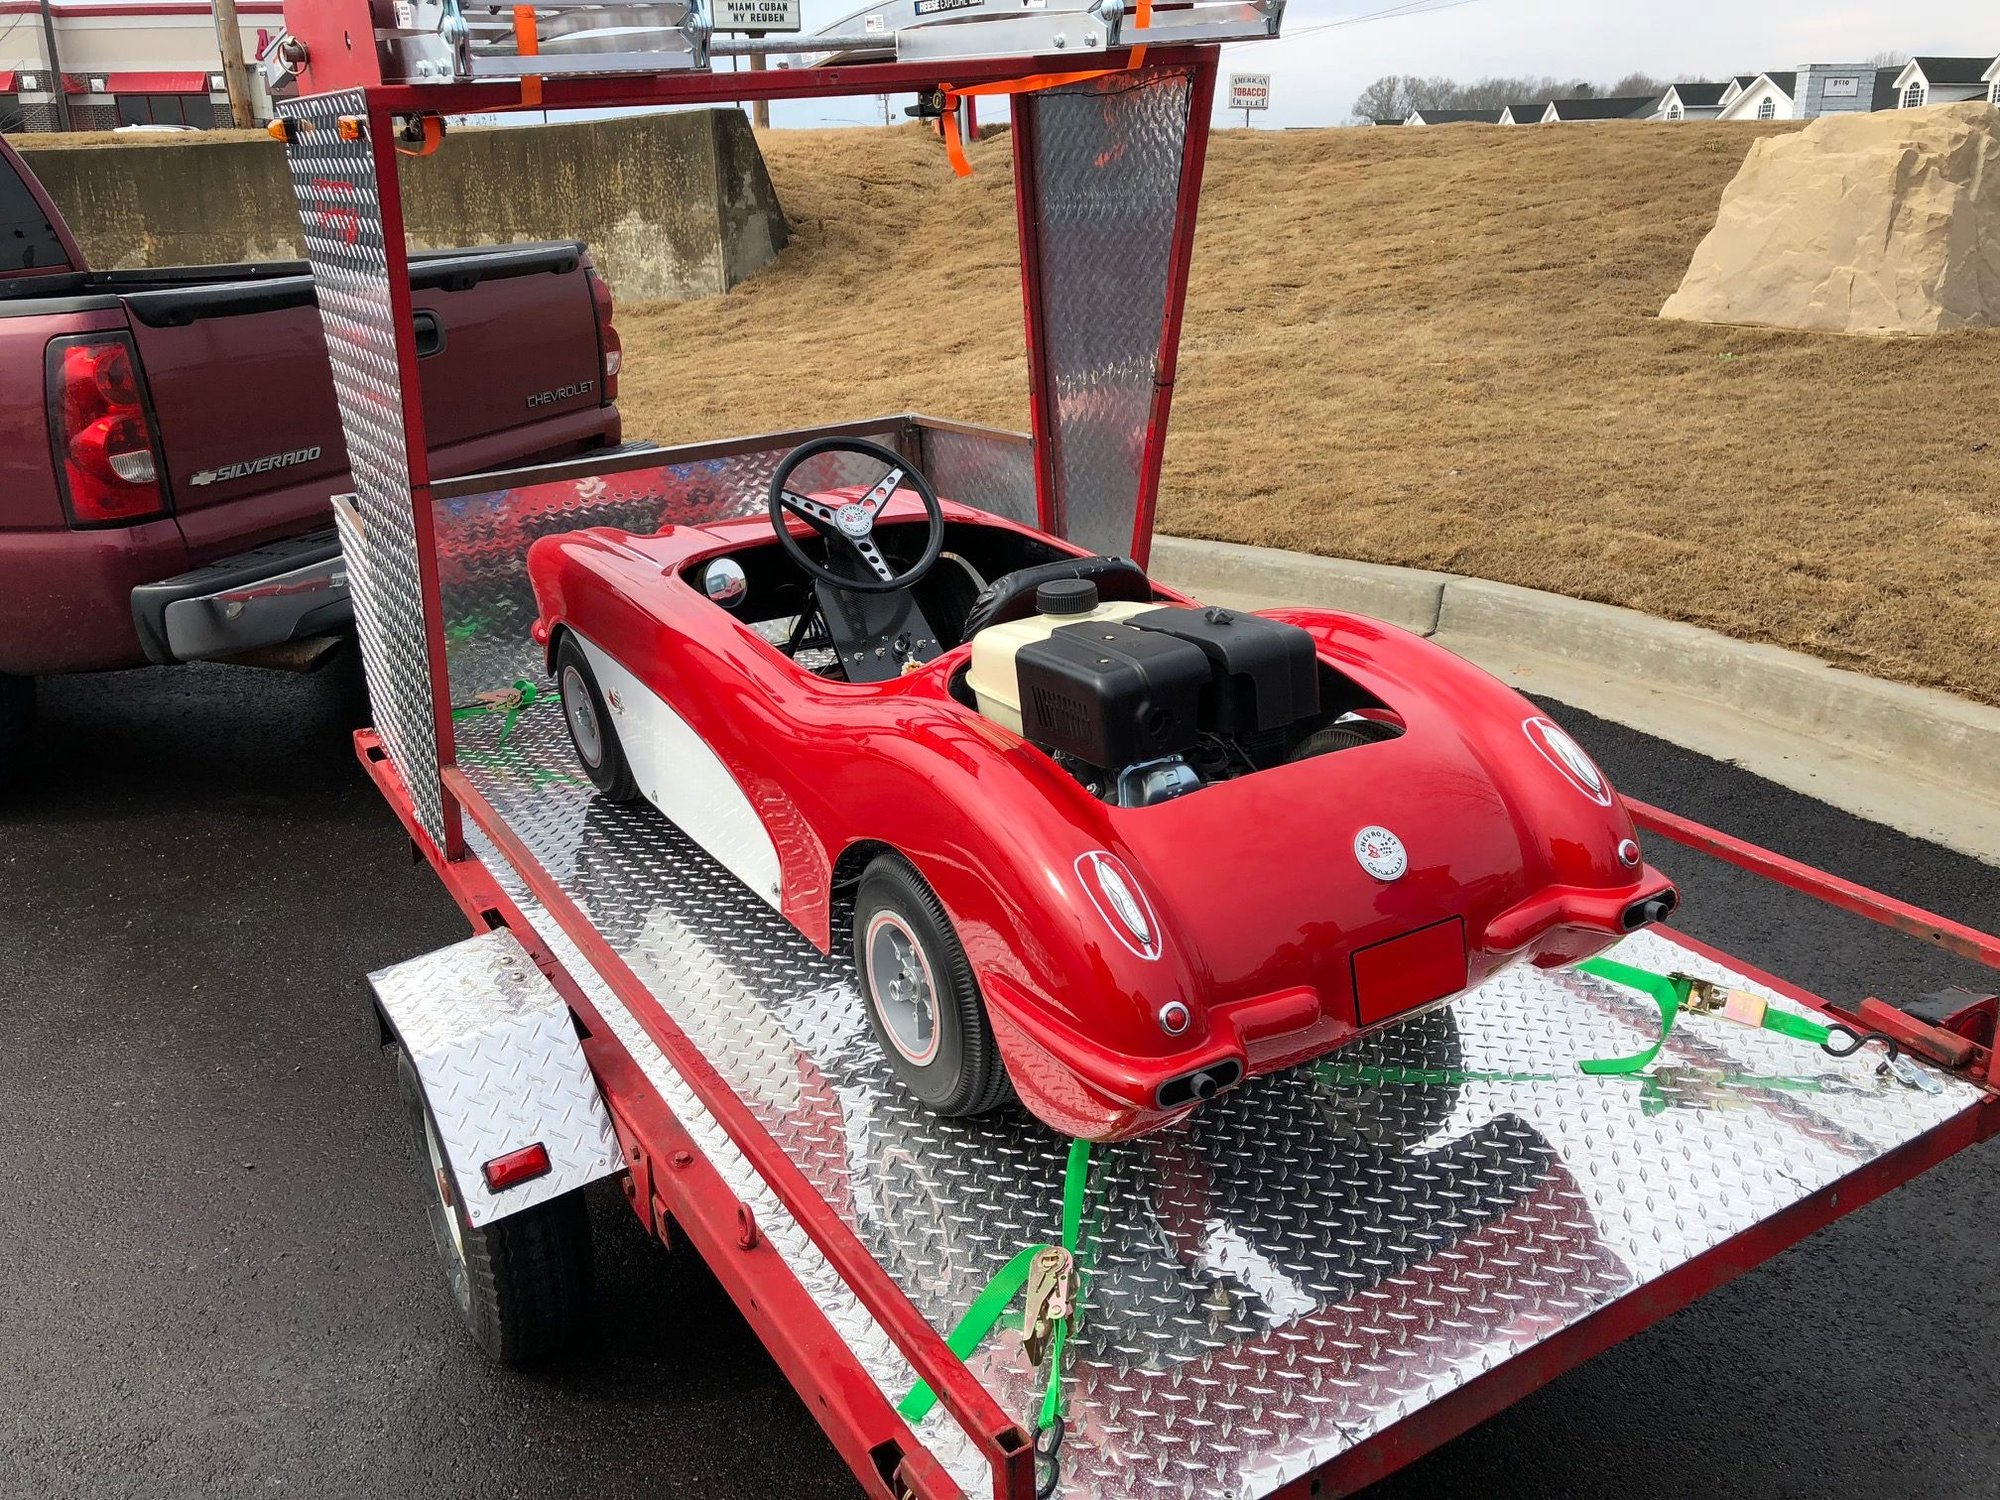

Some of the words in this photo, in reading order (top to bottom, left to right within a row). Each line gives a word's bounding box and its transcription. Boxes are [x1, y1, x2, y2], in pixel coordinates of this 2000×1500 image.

[727, 2, 756, 11] MIAMI
[759, 2, 788, 11] CUBAN
[919, 0, 940, 12] REESE
[733, 13, 746, 22] NY
[750, 13, 785, 22] REUBEN
[1233, 77, 1267, 86] AMERICAN
[1233, 87, 1267, 97] TOBACCO
[527, 380, 595, 408] CHEVROLET
[216, 446, 321, 482] SILVERADO
[840, 506, 867, 519] CHEVROLET
[1360, 831, 1397, 853] CHEVROLET
